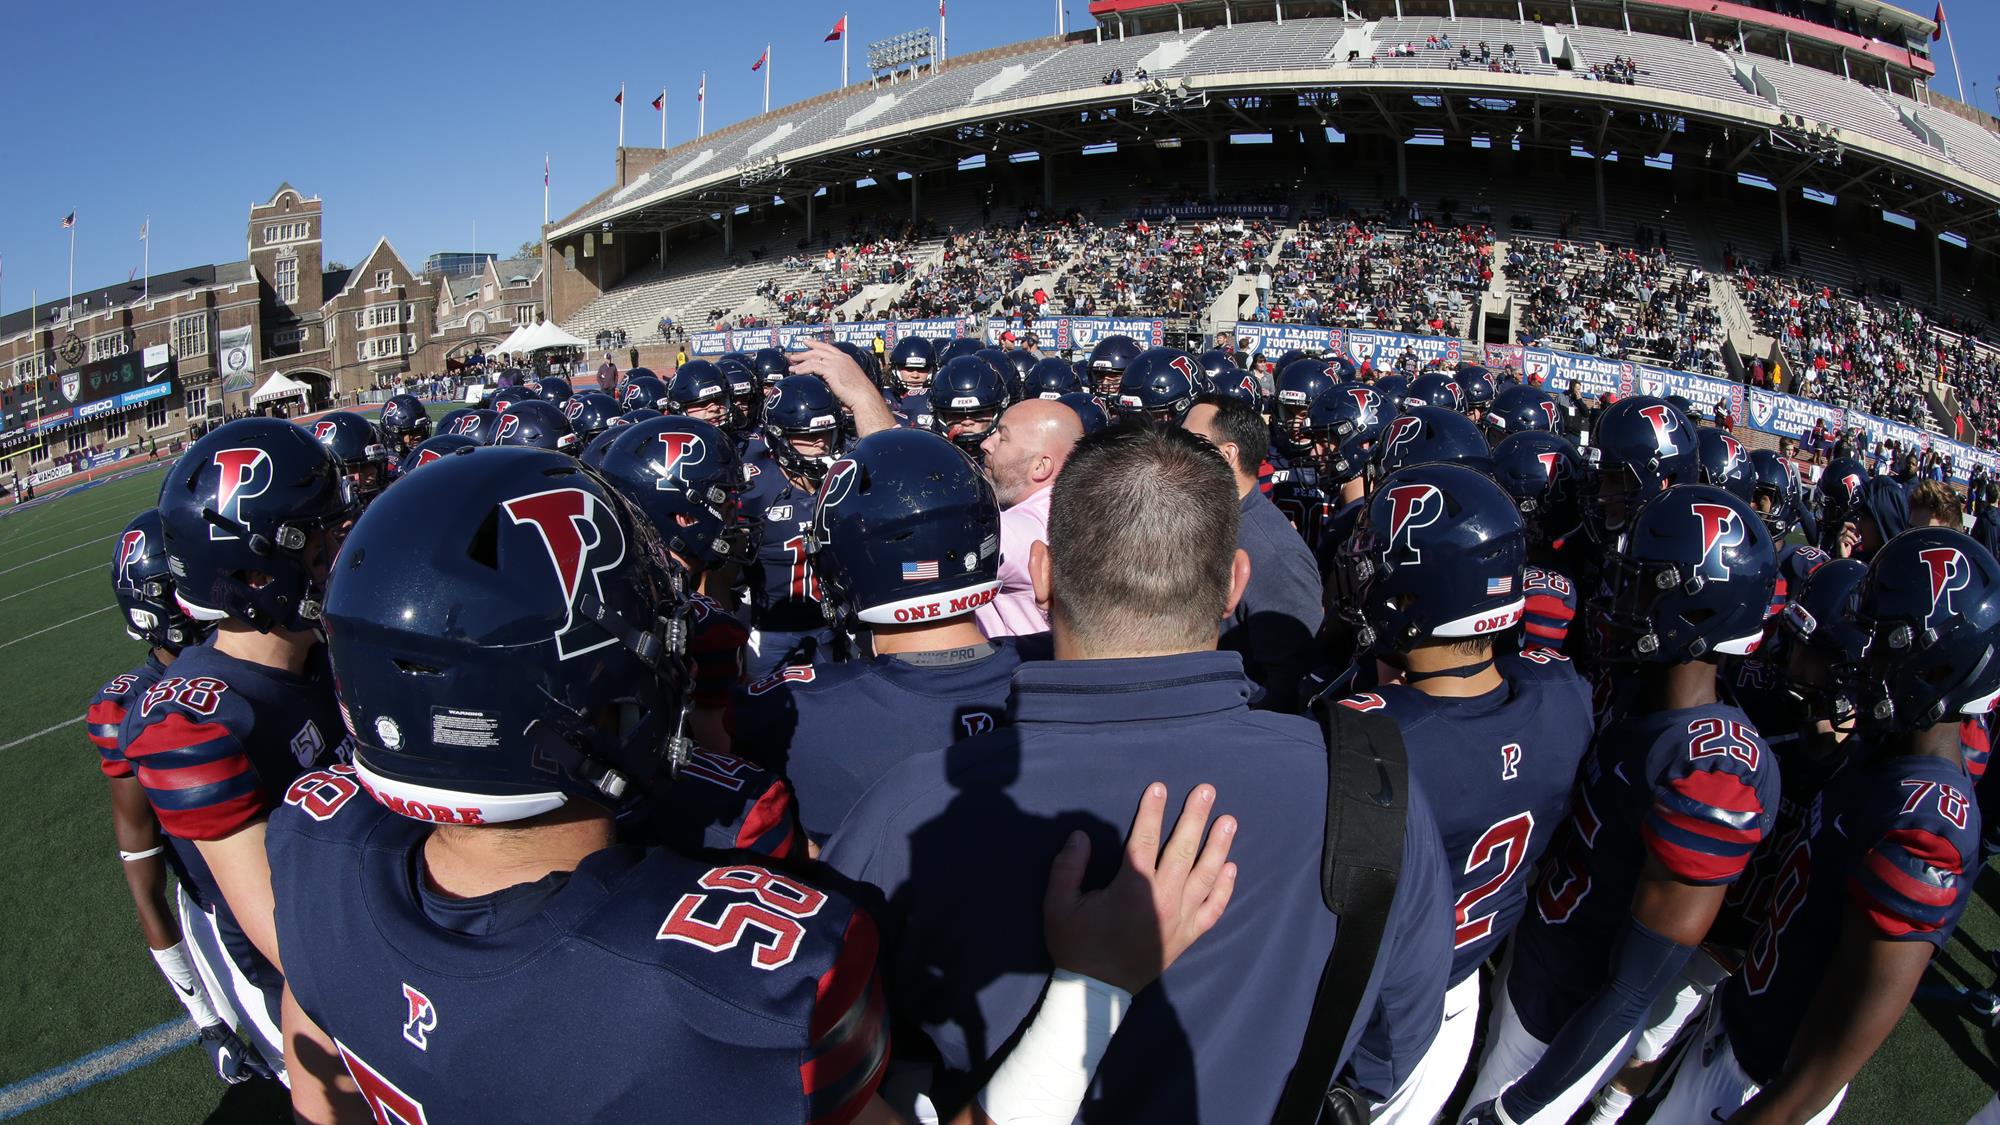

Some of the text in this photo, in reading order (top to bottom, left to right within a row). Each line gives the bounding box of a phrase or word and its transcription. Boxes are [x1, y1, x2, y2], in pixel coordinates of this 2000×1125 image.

[862, 323, 886, 332] LEAGUE
[912, 321, 956, 330] IVY LEAGUE
[915, 330, 952, 338] FOOTBALL
[1058, 319, 1068, 349] 1986
[1094, 321, 1151, 331] IVY LEAGUE
[1152, 320, 1163, 346] 988
[1261, 327, 1328, 340] IVY LEAGUE
[1352, 335, 1372, 343] PENN
[1266, 338, 1321, 350] FOOTBALL
[1376, 335, 1446, 351] IVY LEAGUE
[63, 374, 78, 383] PENN
[105, 371, 119, 384] VS
[1169, 356, 1203, 397] P
[1550, 355, 1619, 375] IVY LEAGUE
[1556, 367, 1614, 386] FOOTBALL
[1642, 371, 1663, 381] PENN
[125, 388, 161, 402] Independence
[1666, 374, 1731, 396] IVY LEAGUE
[80, 400, 113, 416] GEICO
[1347, 388, 1382, 425] P
[1731, 385, 1743, 424] 2002
[1758, 404, 1768, 419] P
[1774, 396, 1833, 422] IVY LEAGUE
[1778, 409, 1816, 427] FOOTBA
[2, 434, 32, 449] ROBERT
[34, 426, 54, 438] WOLF
[64, 414, 92, 429] FAMILY
[95, 400, 149, 420] SCOREBOARD
[494, 413, 520, 447] P
[1638, 404, 1679, 459] P
[1887, 425, 1920, 443] LEAGUE
[656, 432, 706, 491] P
[1720, 435, 1748, 480] P
[1952, 444, 1995, 466] IVY LEAGUE
[1537, 452, 1573, 504] P
[210, 447, 273, 541] P
[813, 459, 857, 545] P
[799, 521, 813, 532] PE
[1382, 484, 1444, 565] P
[1691, 503, 1745, 582] P
[117, 529, 146, 589] P
[502, 488, 625, 661] P
[1523, 568, 1570, 595] 28
[1919, 547, 1970, 630] P
[894, 586, 1000, 623] ONE MORE
[1474, 614, 1508, 633] ONE
[950, 647, 975, 660] PRO
[104, 674, 138, 695] 5
[141, 677, 229, 717] 88
[448, 709, 484, 717] WARNING
[1688, 718, 1760, 772] 25
[1501, 743, 1522, 781] P
[284, 765, 359, 822] 8
[1899, 779, 1970, 830] 78
[379, 791, 486, 826] MORE
[1455, 811, 1535, 950] 2
[657, 865, 829, 971] 58
[401, 982, 438, 1052] P
